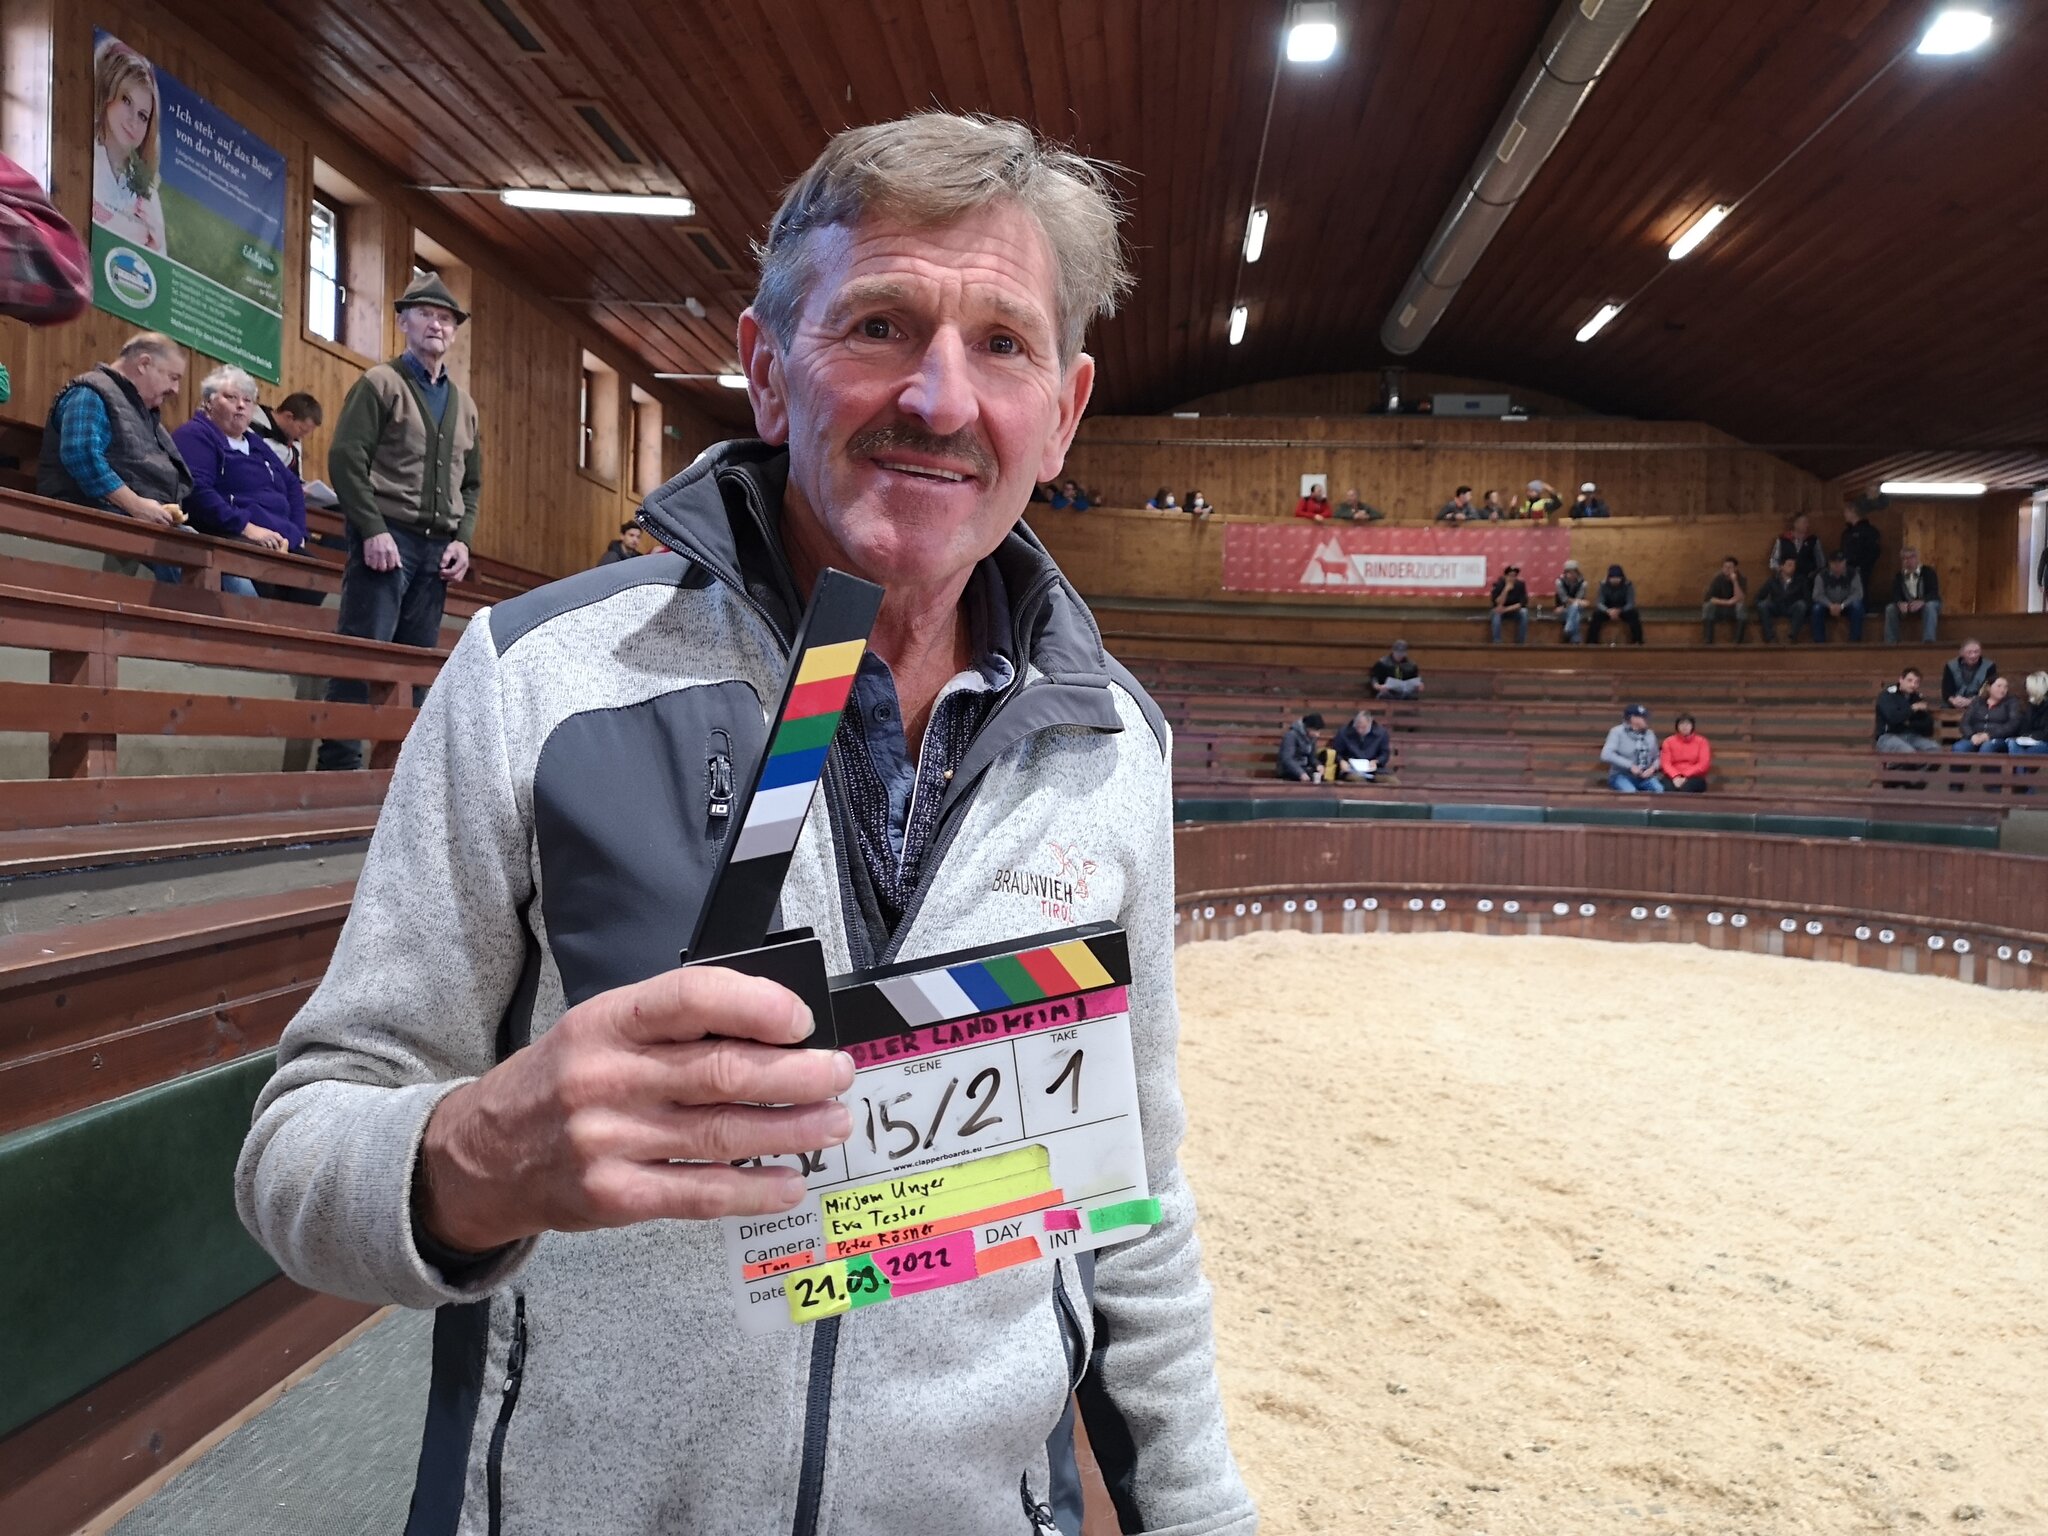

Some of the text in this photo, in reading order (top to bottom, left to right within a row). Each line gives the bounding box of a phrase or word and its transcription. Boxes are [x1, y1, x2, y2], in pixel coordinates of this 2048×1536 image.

[175, 128, 193, 147] von
[195, 139, 212, 157] der
[217, 135, 235, 155] auf
[235, 146, 251, 165] das
[251, 155, 273, 180] Beste
[1364, 561, 1457, 580] RINDERZUCHT
[991, 869, 1073, 904] BRAUNVIEH
[1040, 900, 1075, 923] TIROL
[851, 1031, 920, 1062] OLER
[1050, 1029, 1078, 1044] TAKE
[903, 1058, 942, 1076] SCENE
[1044, 1049, 1084, 1114] 1
[861, 1066, 1004, 1160] 15/2
[892, 1144, 983, 1173] www.clapperboards.eu
[825, 1192, 884, 1215] Mirjam
[740, 1211, 818, 1240] Director:
[832, 1220, 862, 1235] Eva
[985, 1221, 1023, 1244] DAY
[744, 1236, 822, 1264] Camera:
[837, 1241, 872, 1255] Peter
[1049, 1230, 1077, 1249] INT
